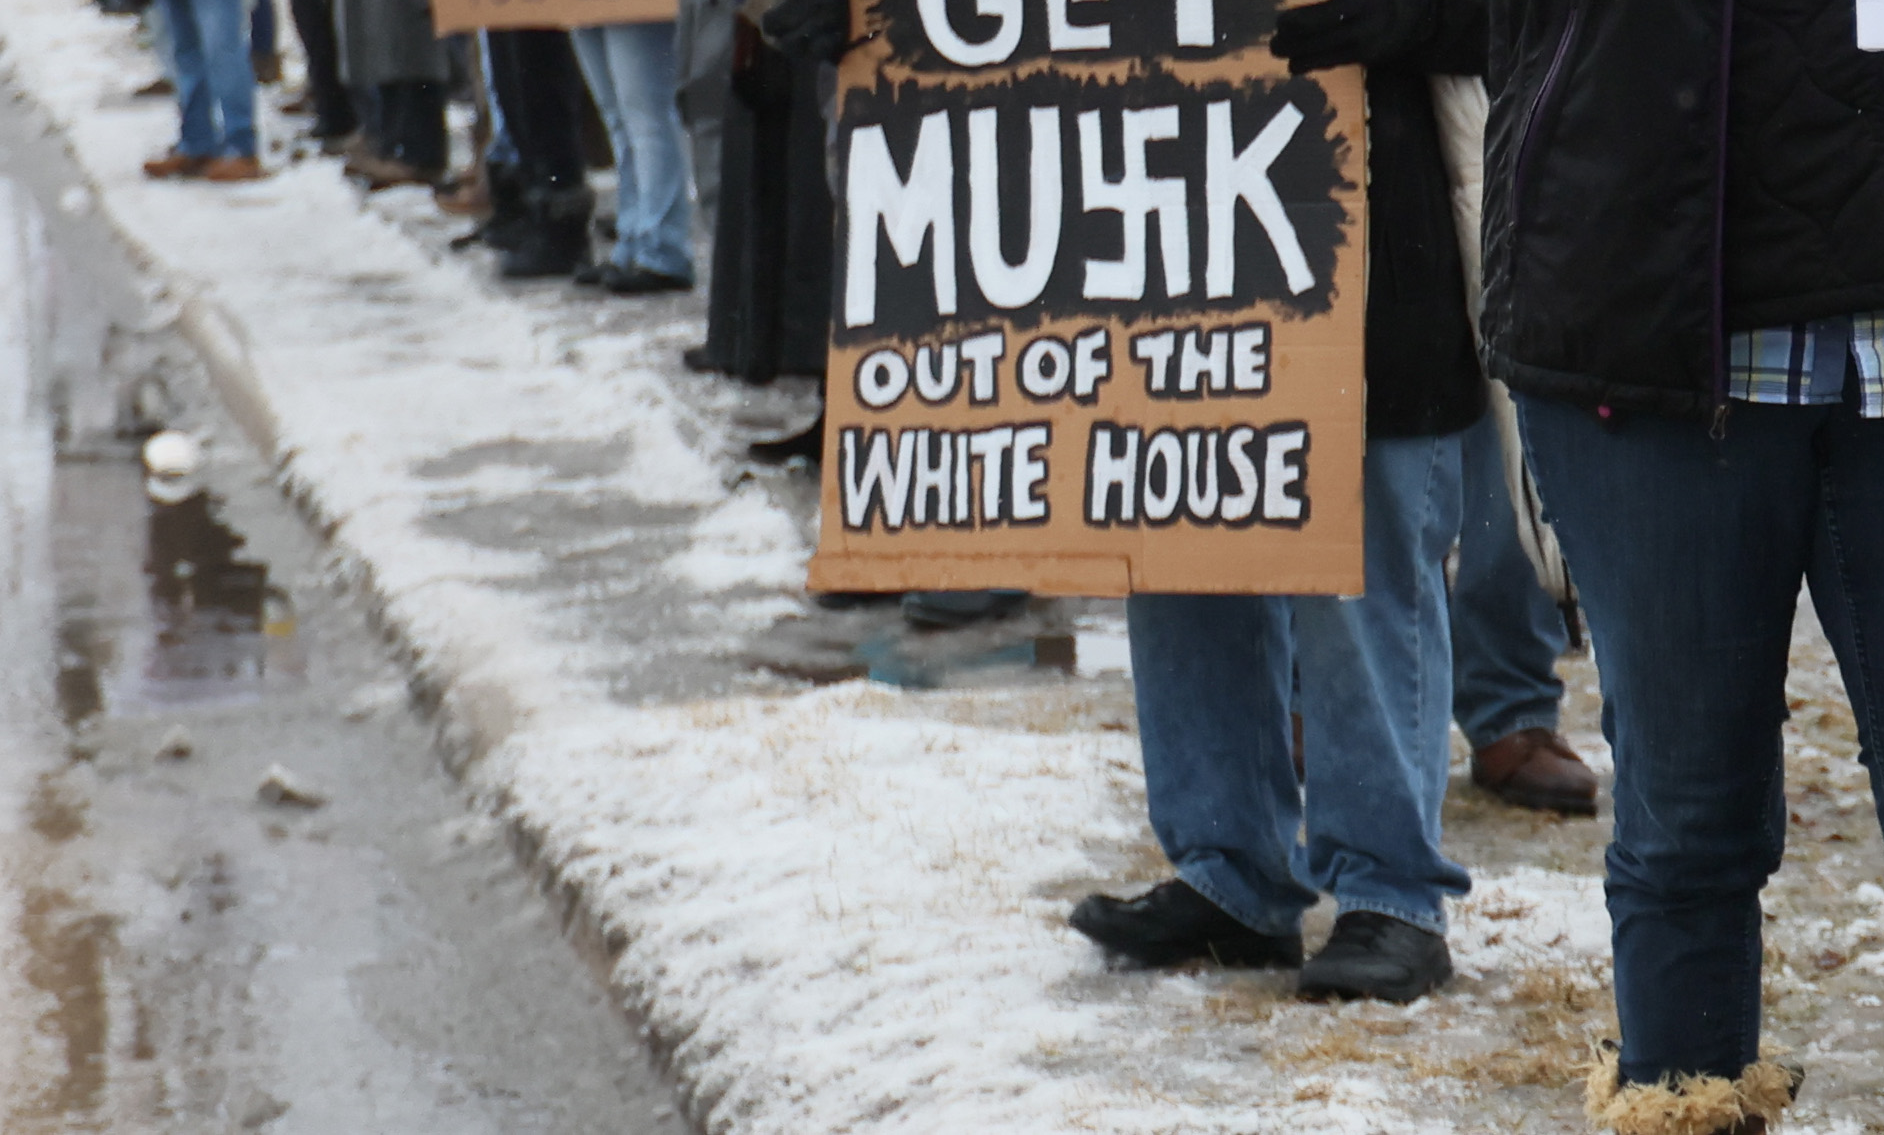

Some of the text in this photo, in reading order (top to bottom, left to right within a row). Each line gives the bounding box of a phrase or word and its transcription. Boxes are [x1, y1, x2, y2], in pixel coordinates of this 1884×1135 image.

[859, 327, 1266, 408] OUT OF THE
[842, 427, 1306, 528] WHITE HOUSE
